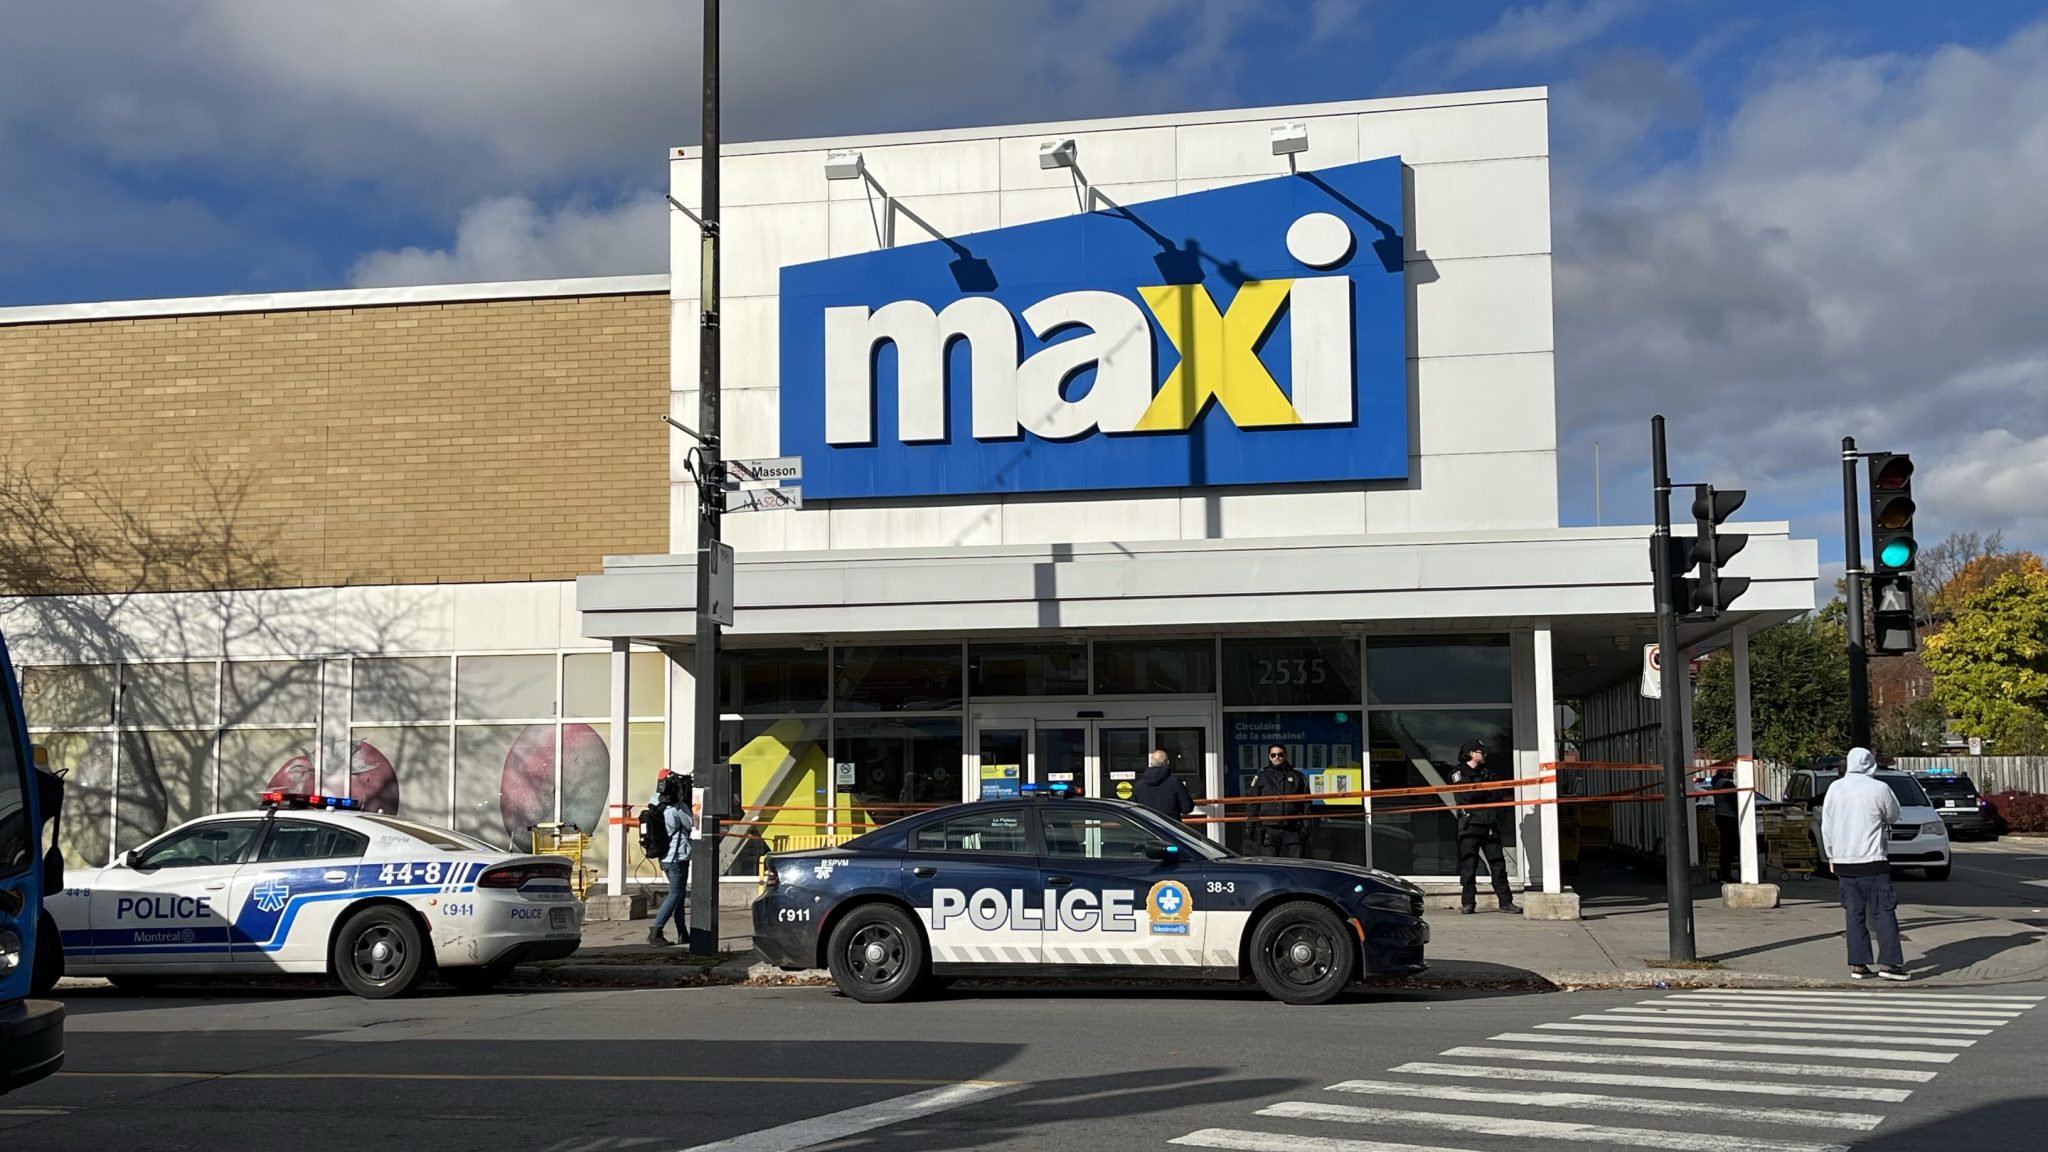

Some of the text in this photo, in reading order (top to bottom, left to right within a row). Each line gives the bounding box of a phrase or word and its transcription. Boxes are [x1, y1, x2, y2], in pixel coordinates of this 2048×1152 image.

[824, 212, 1353, 444] maxi
[752, 466, 796, 477] Masson
[1258, 659, 1326, 685] 2535
[1235, 722, 1281, 731] Circulaire
[1235, 731, 1306, 740] de la semaine!
[827, 859, 849, 867] SPVM
[378, 862, 442, 885] 44-8
[66, 888, 91, 897] 44-8
[1206, 881, 1235, 893] 38-3
[117, 896, 211, 920] POLICE
[511, 908, 542, 920] POLICE
[931, 886, 1137, 933] POLICE
[786, 908, 810, 922] 911
[134, 930, 181, 942] Montréal
